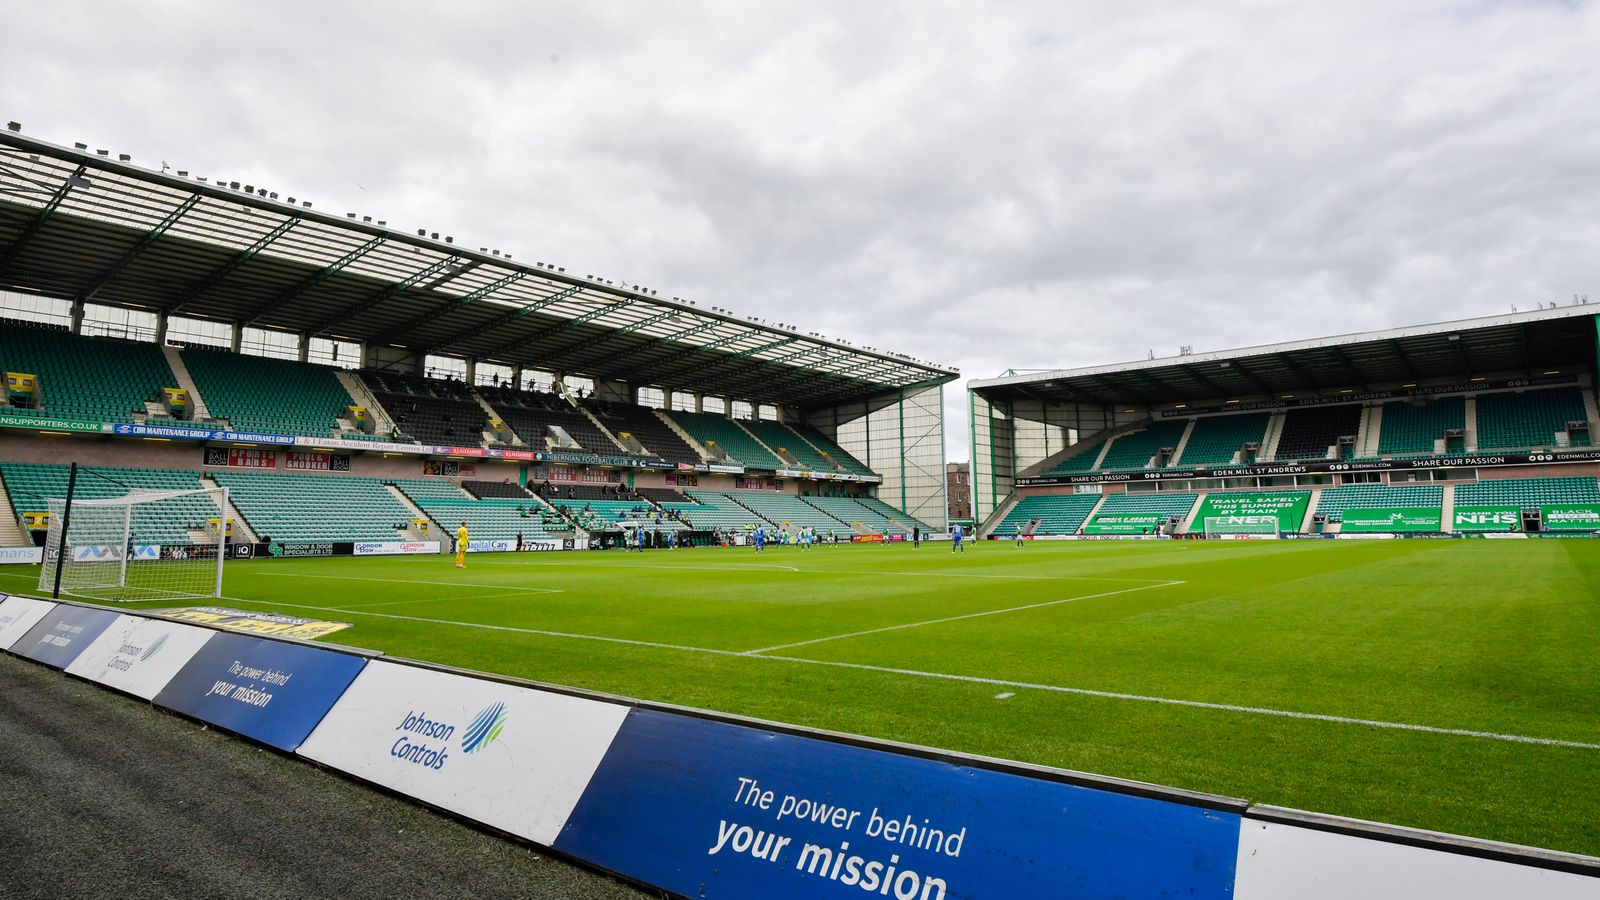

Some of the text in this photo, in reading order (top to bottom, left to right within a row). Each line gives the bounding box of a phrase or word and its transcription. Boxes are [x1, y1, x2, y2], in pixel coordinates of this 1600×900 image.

[1435, 385, 1453, 393] OUR
[1454, 382, 1490, 391] PASSION
[1353, 391, 1392, 400] ANDREWS
[1257, 401, 1286, 409] PASSION
[133, 426, 146, 434] CBR
[147, 427, 189, 437] MAINTENANCE
[226, 432, 238, 440] CBR
[239, 433, 275, 443] MAINTENANCE
[340, 440, 371, 448] Accident
[372, 442, 394, 451] Repair
[396, 444, 420, 452] Centres
[231, 448, 274, 459] SPORTS
[292, 452, 323, 461] POOL &
[547, 454, 580, 462] HIBERNIAN
[582, 456, 613, 464] FOOTBALL
[237, 458, 267, 467] BARS
[287, 460, 328, 469] SNOOKER
[1412, 456, 1505, 467] SHARE OUR PASSION
[1267, 466, 1307, 474] ANDREWS
[1215, 515, 1274, 524] LNER
[1456, 514, 1518, 524] NHS
[491, 540, 508, 548] Cars
[238, 546, 249, 554] IQ
[227, 660, 293, 686] The power behind
[205, 680, 273, 707] your mission
[395, 710, 455, 741] Johnson
[390, 736, 449, 770] Controls
[734, 776, 967, 858] The power behind
[708, 819, 947, 900] your mission
